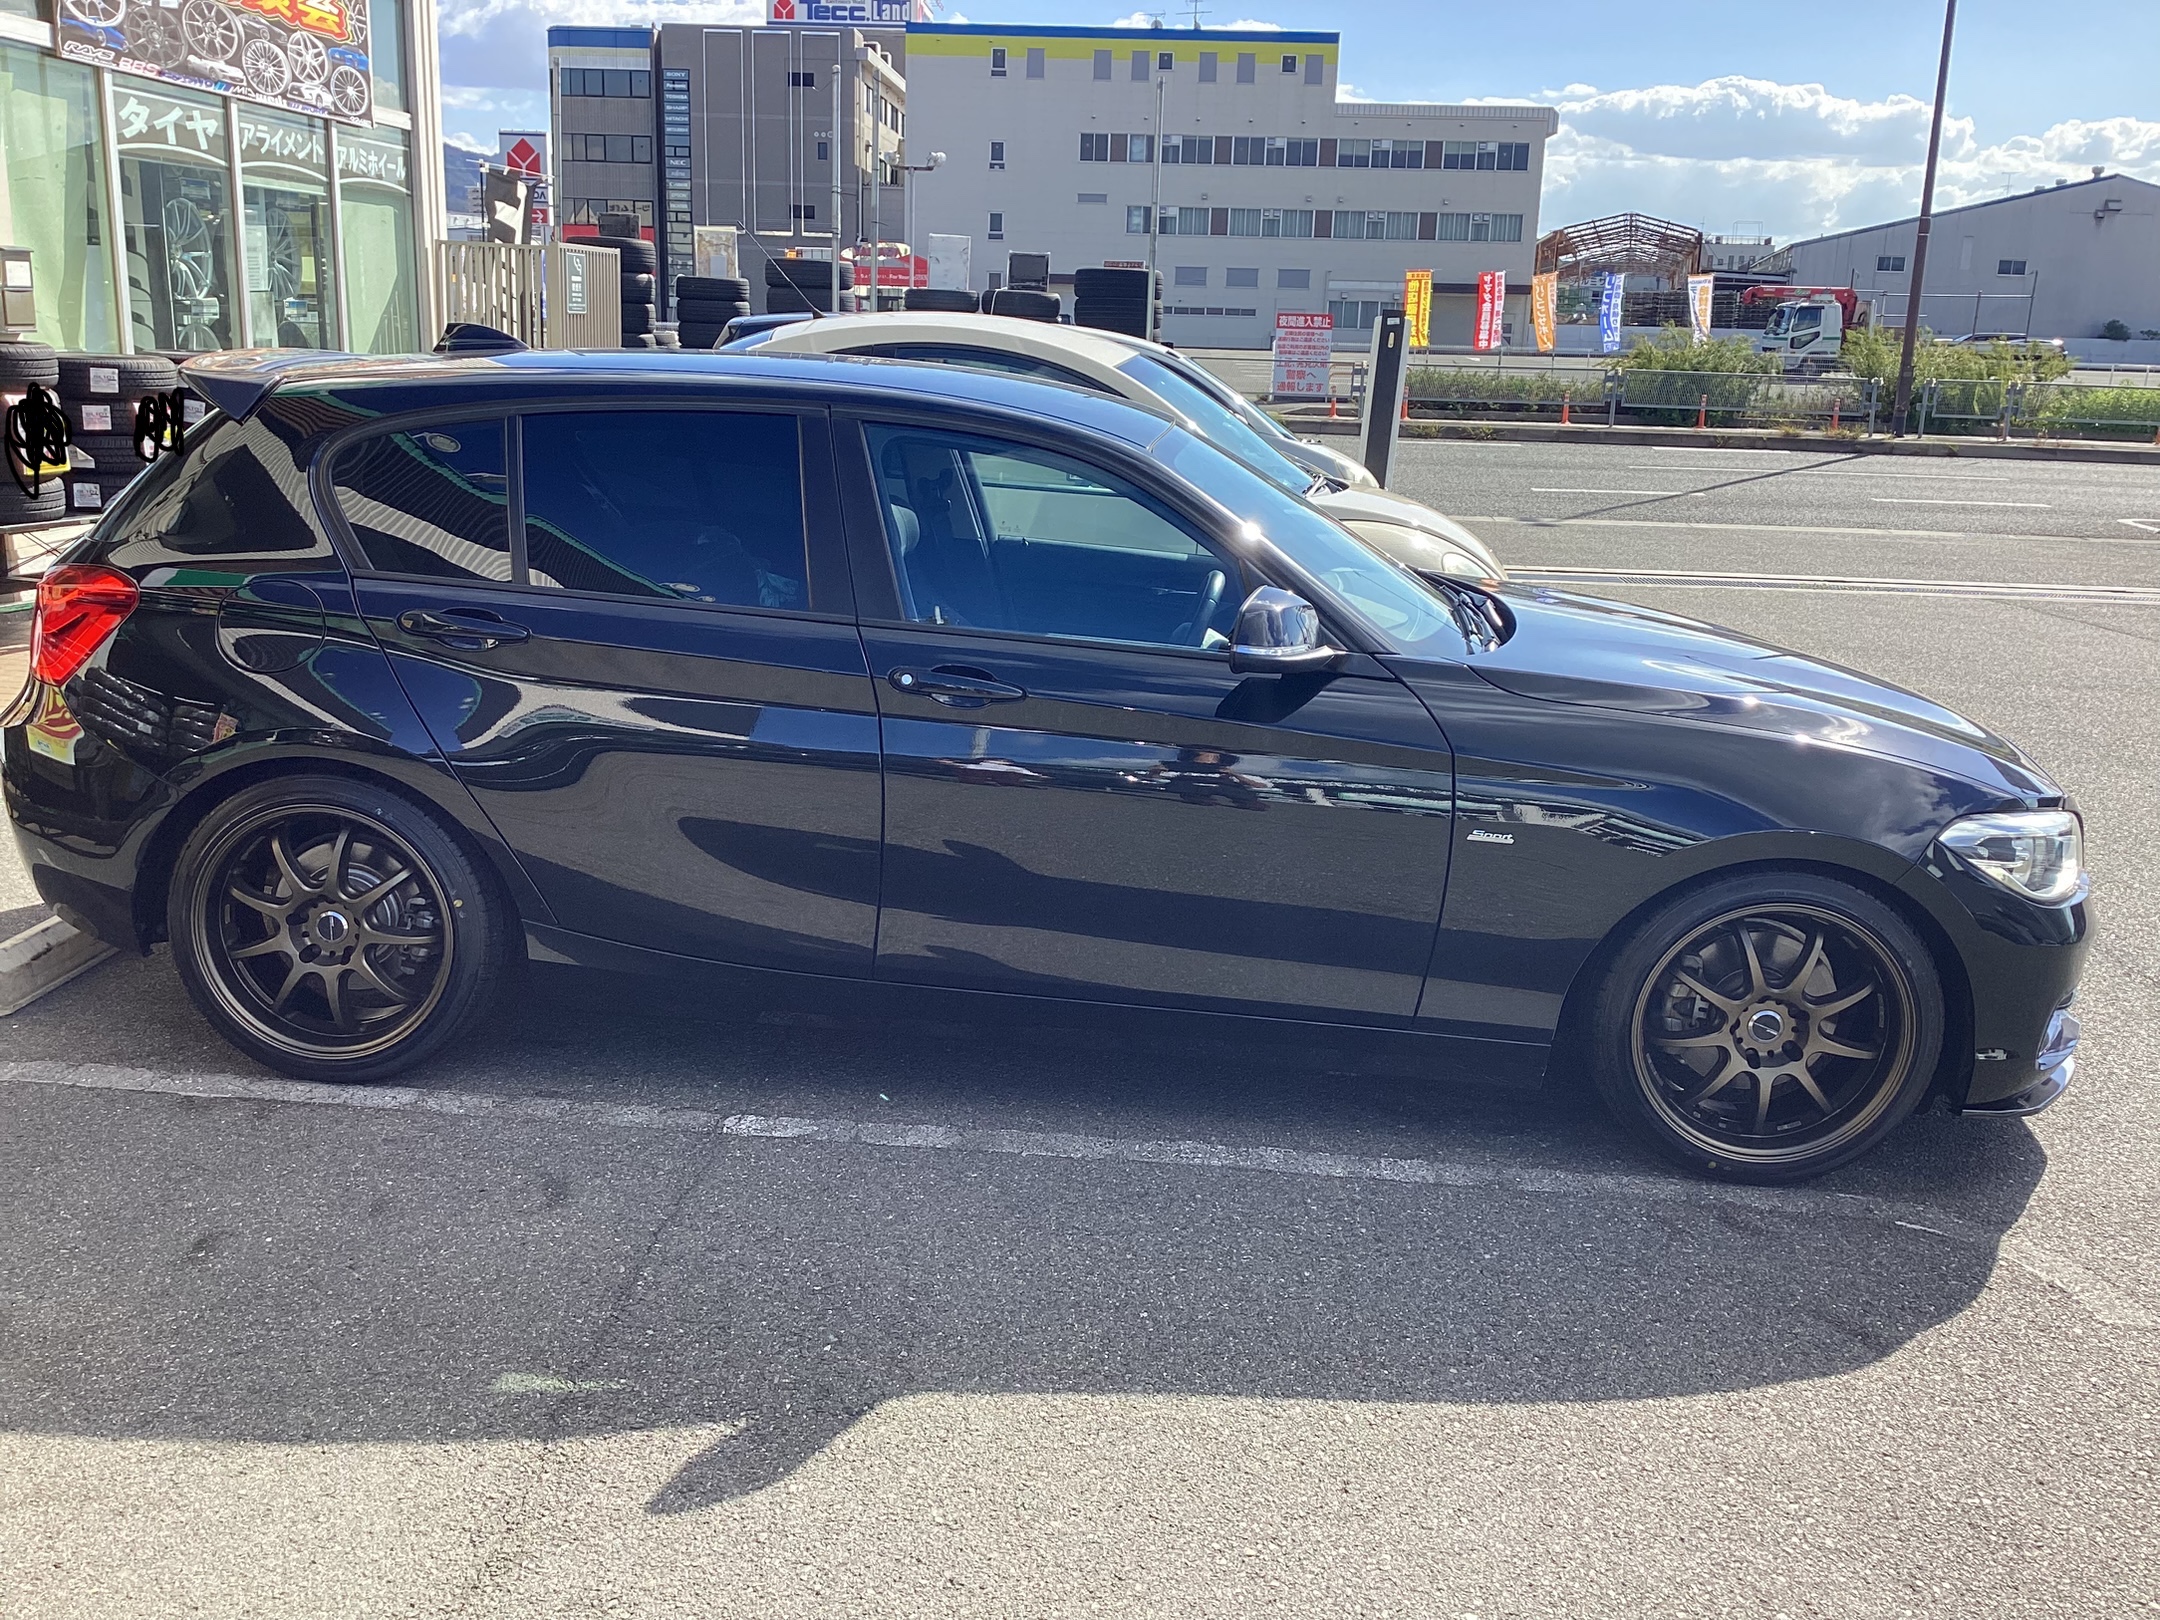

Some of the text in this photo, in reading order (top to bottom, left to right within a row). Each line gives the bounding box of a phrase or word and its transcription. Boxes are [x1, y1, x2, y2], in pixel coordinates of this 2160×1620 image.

[64, 40, 116, 61] RAYS
[119, 57, 161, 77] BBS
[118, 96, 218, 150] タイヤ
[239, 121, 325, 164] アライメント
[337, 145, 406, 179] アルミホイール
[1286, 369, 1317, 380] 警察へ
[1277, 381, 1324, 392] 通報します
[1471, 829, 1513, 842] Sport
